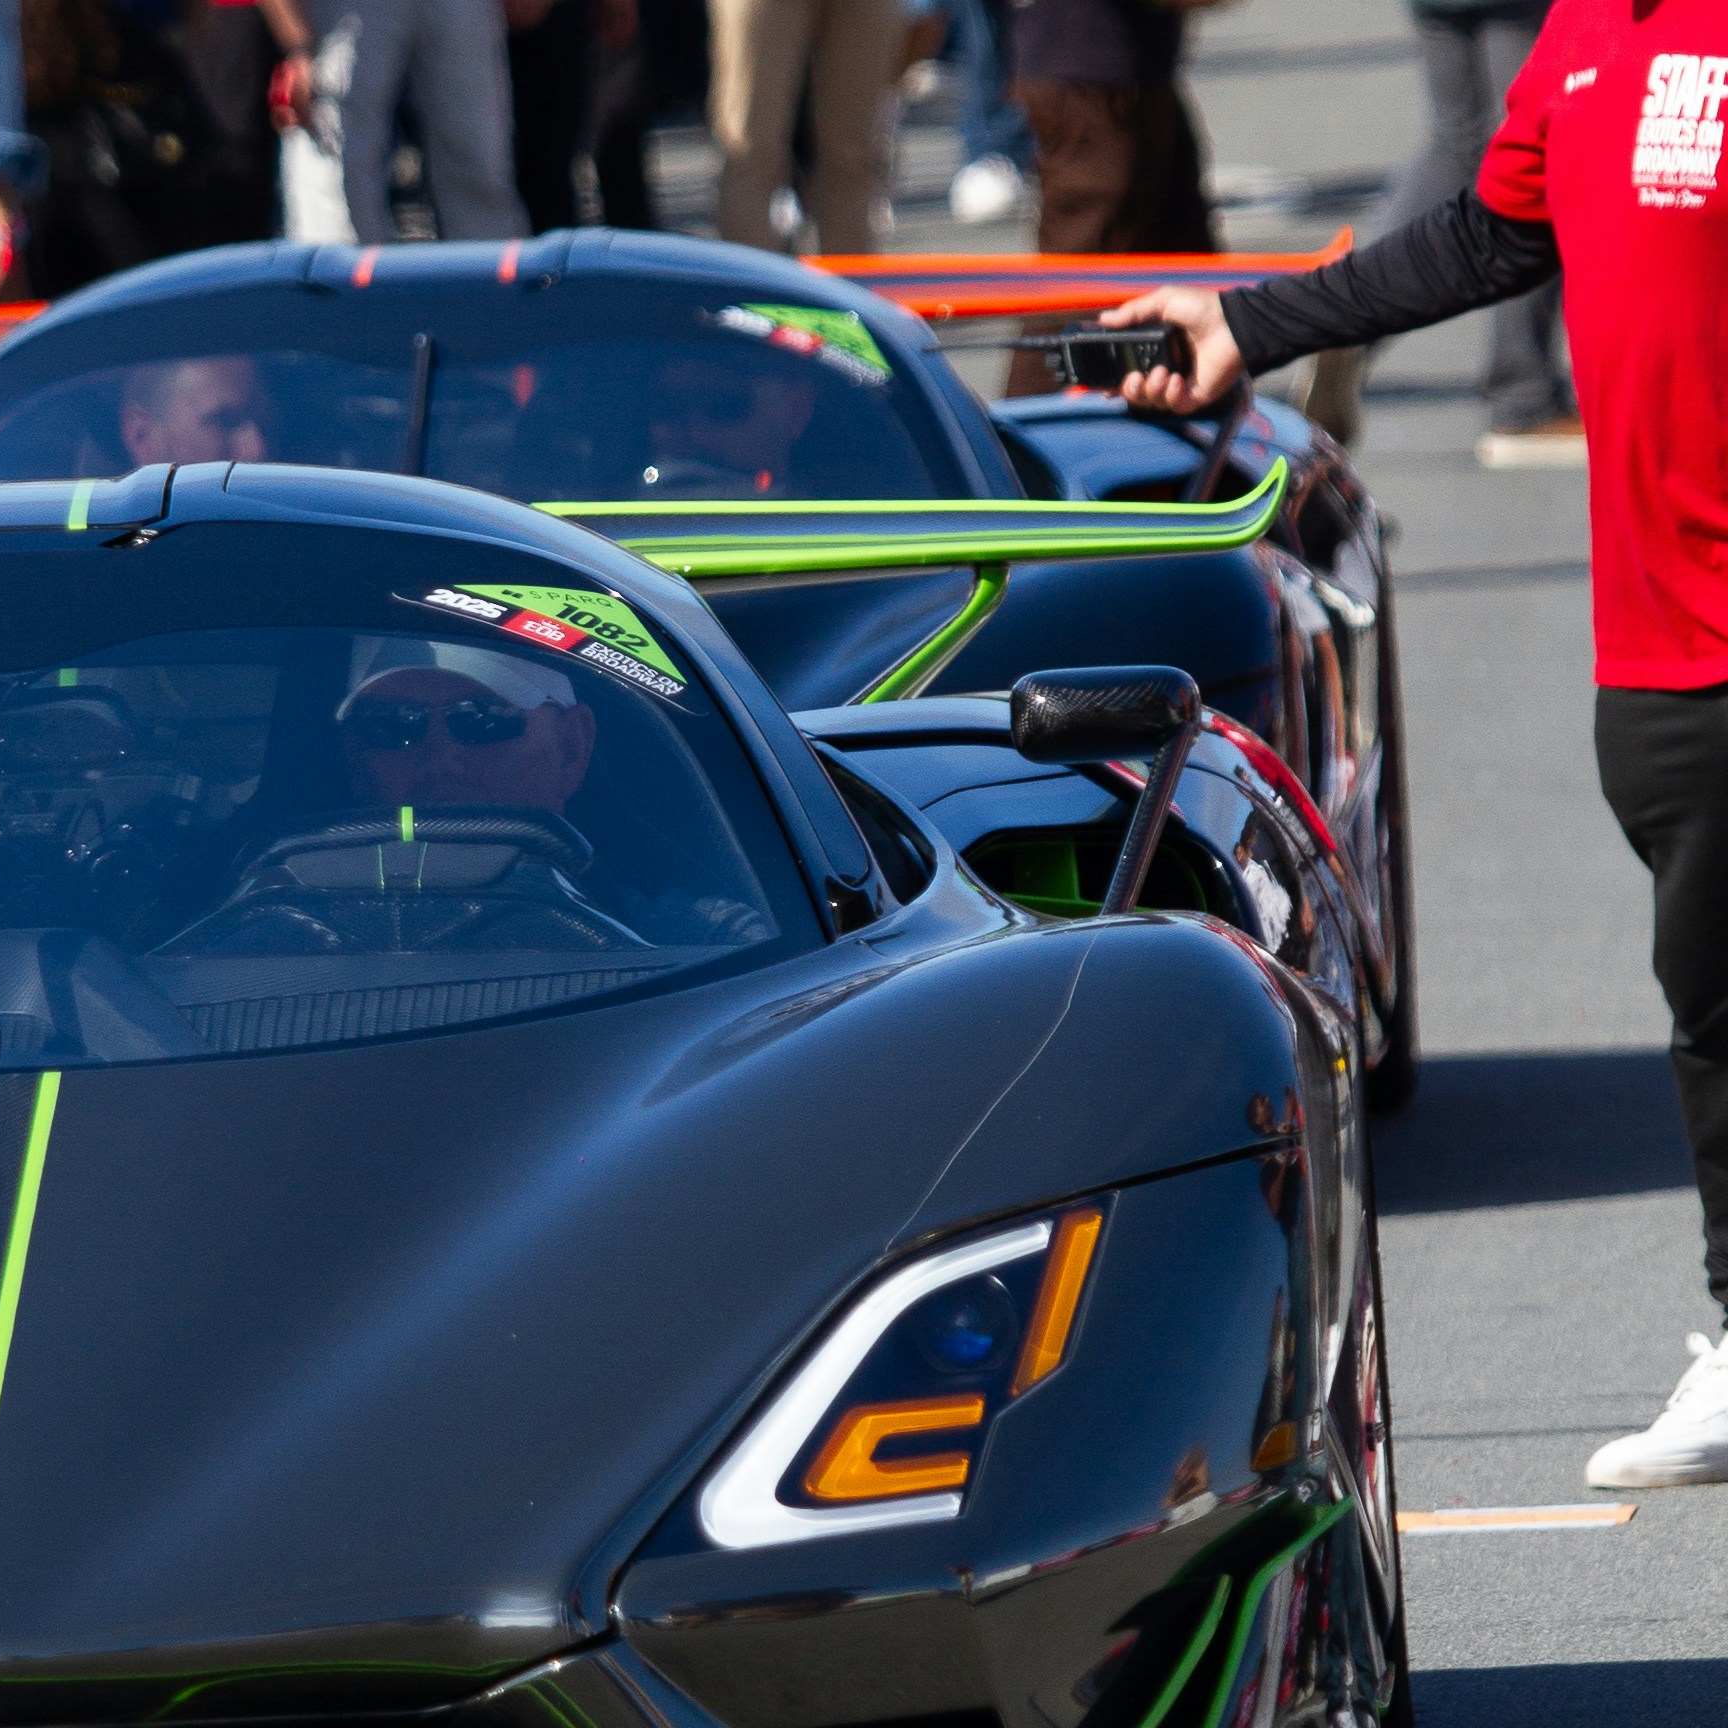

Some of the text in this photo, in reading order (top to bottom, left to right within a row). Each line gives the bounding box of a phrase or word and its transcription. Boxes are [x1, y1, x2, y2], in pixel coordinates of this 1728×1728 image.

[1642, 53, 1728, 120] STAFF
[1637, 117, 1724, 148] EXOTICS ON
[1632, 146, 1722, 177] BROADWAY
[424, 588, 508, 620] 2025
[529, 589, 613, 610] SPARQ
[523, 620, 566, 642] EOB
[555, 603, 651, 653] 1082
[580, 647, 677, 697] BROADWAY
[588, 640, 685, 693] EXOTICS ON
